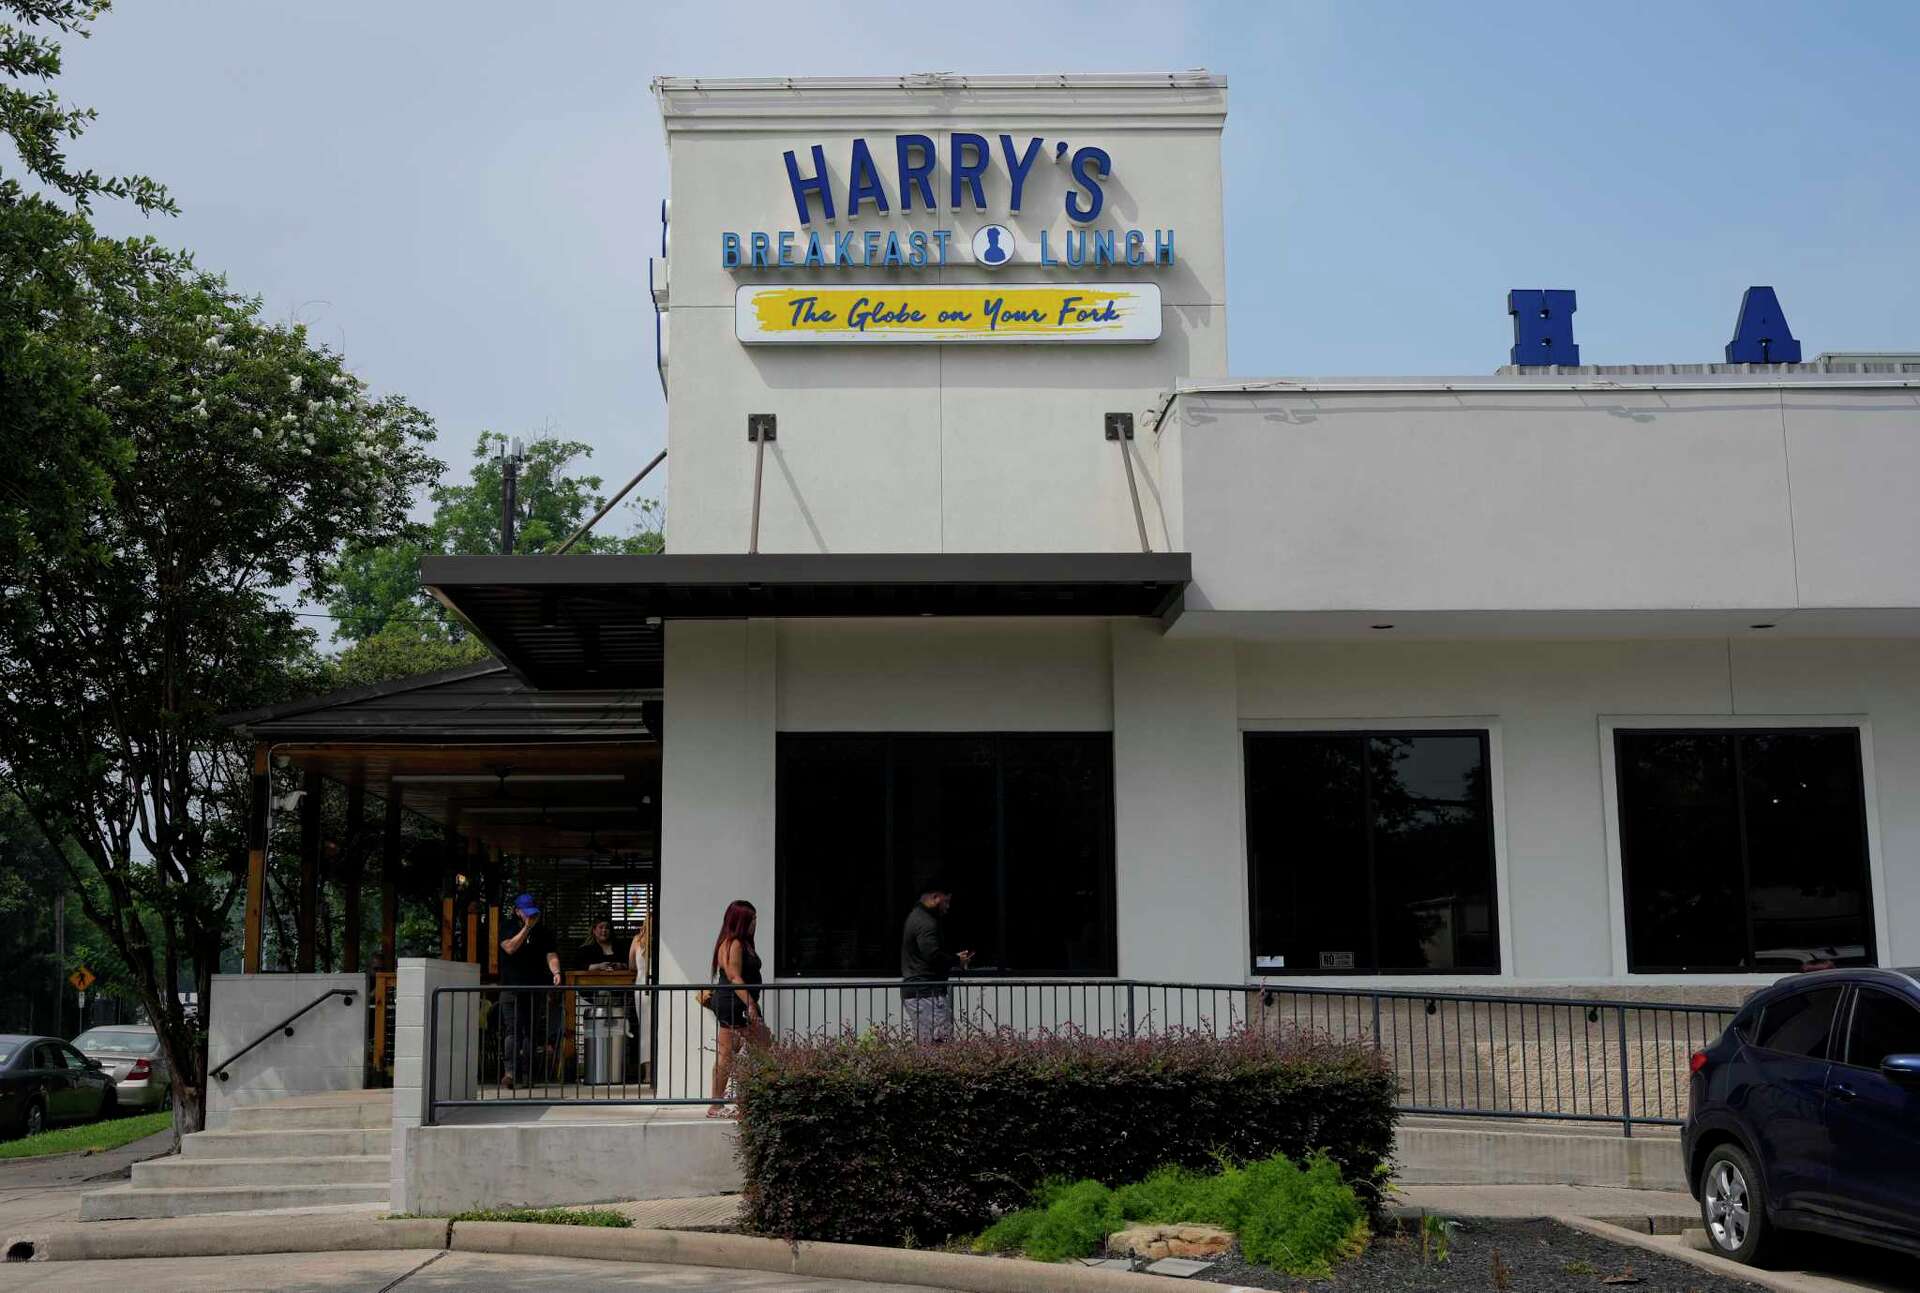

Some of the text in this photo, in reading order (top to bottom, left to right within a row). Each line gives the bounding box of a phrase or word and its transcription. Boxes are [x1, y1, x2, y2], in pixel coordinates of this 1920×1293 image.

[783, 132, 1112, 226] HARRY'S
[722, 230, 1175, 268] BREAKFAST LUNCH
[788, 296, 1120, 331] The Globe on Your Fork
